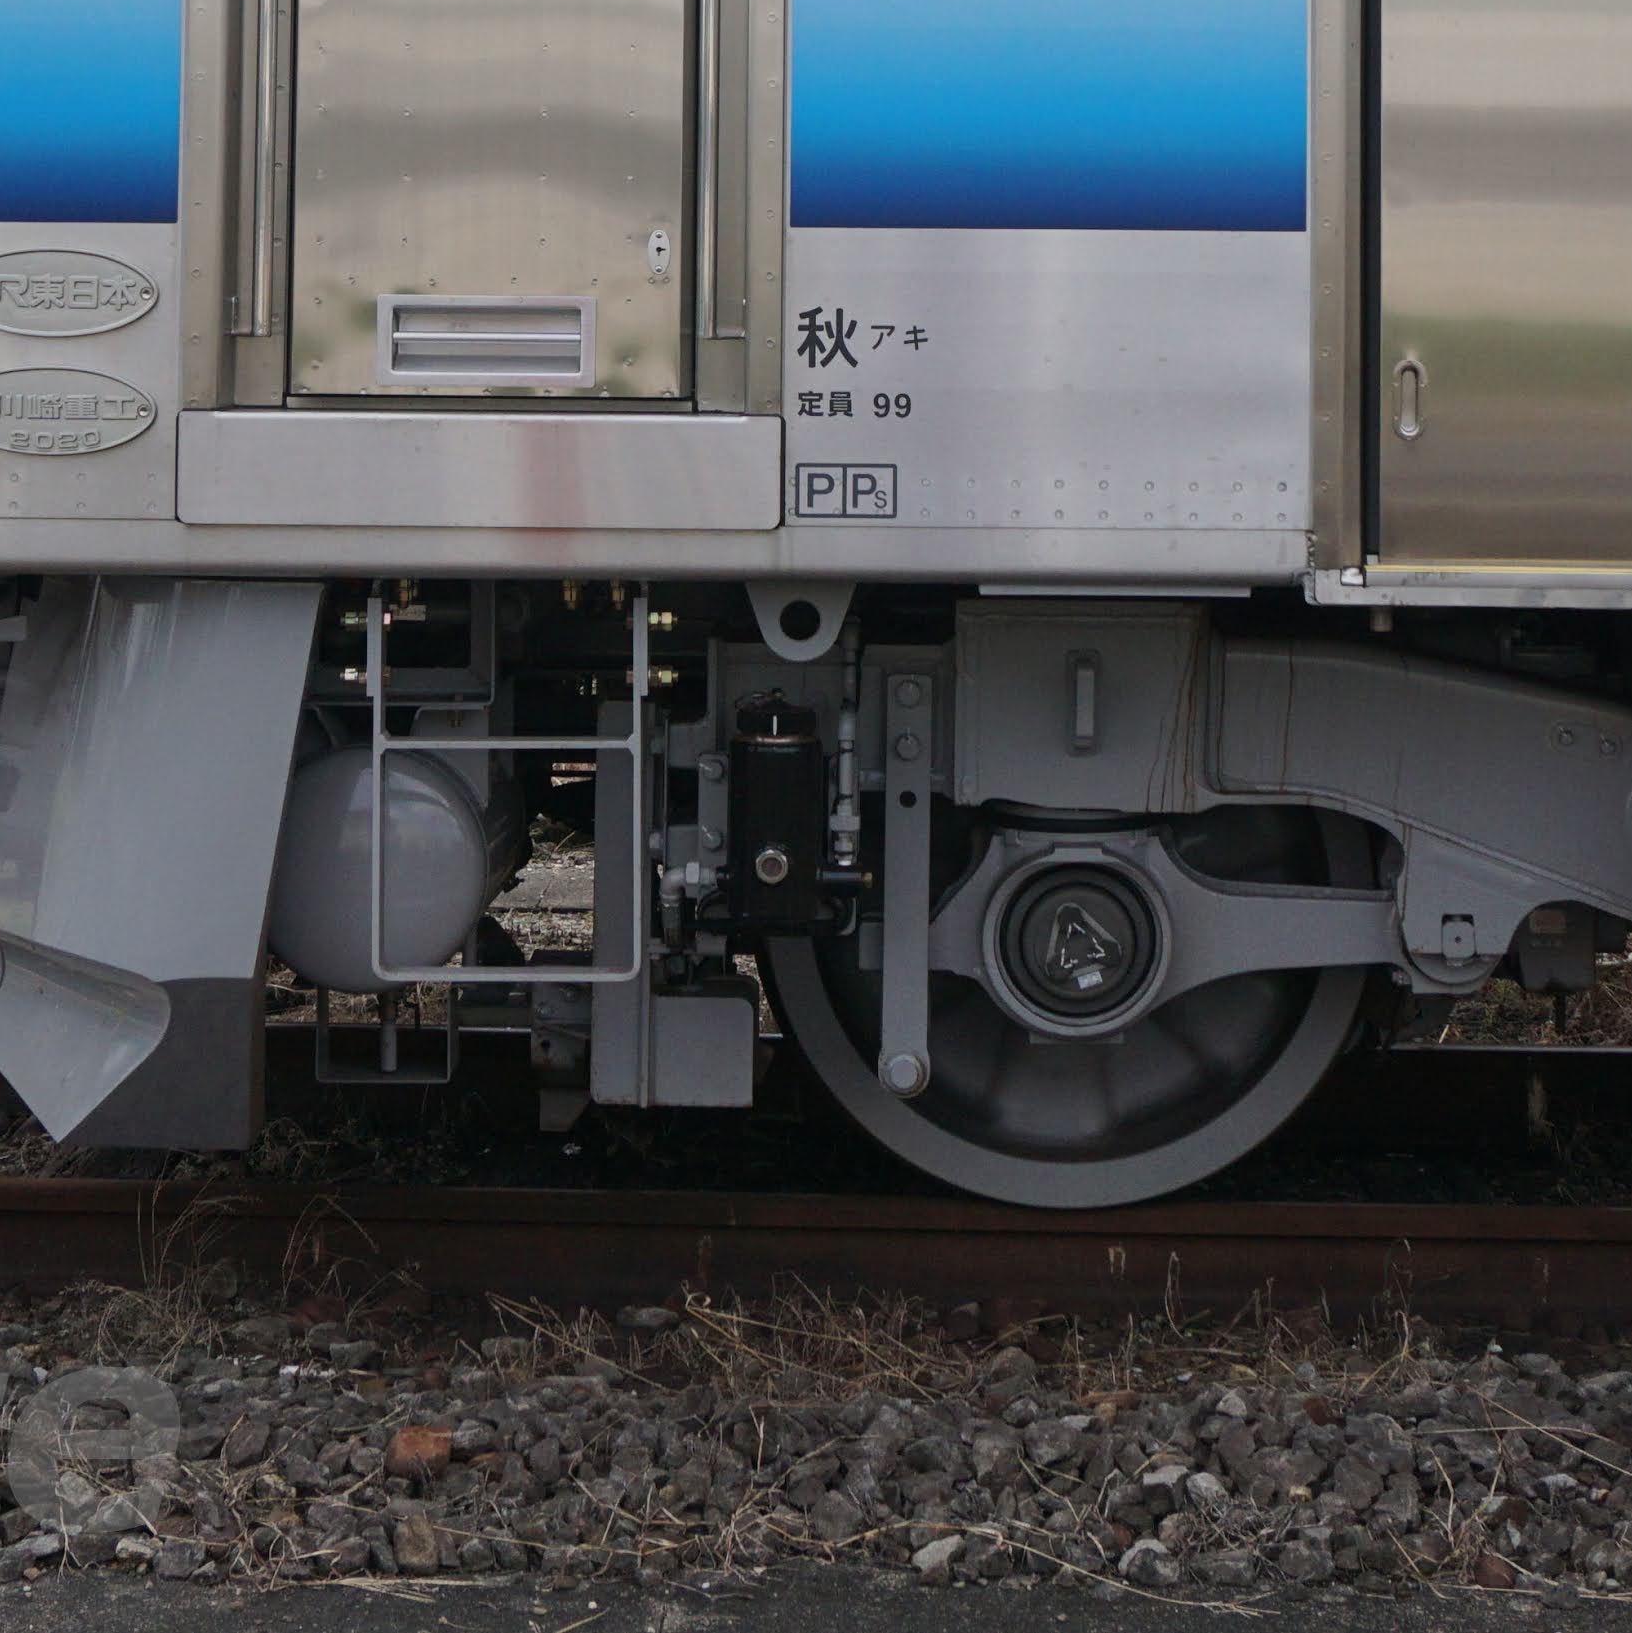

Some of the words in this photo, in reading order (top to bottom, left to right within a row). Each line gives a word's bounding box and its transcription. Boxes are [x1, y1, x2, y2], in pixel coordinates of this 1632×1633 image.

[796, 305, 859, 369] 秋
[870, 324, 930, 351] アキ
[797, 391, 854, 418] 定員
[872, 392, 912, 419] 99
[10, 428, 102, 451] 2020
